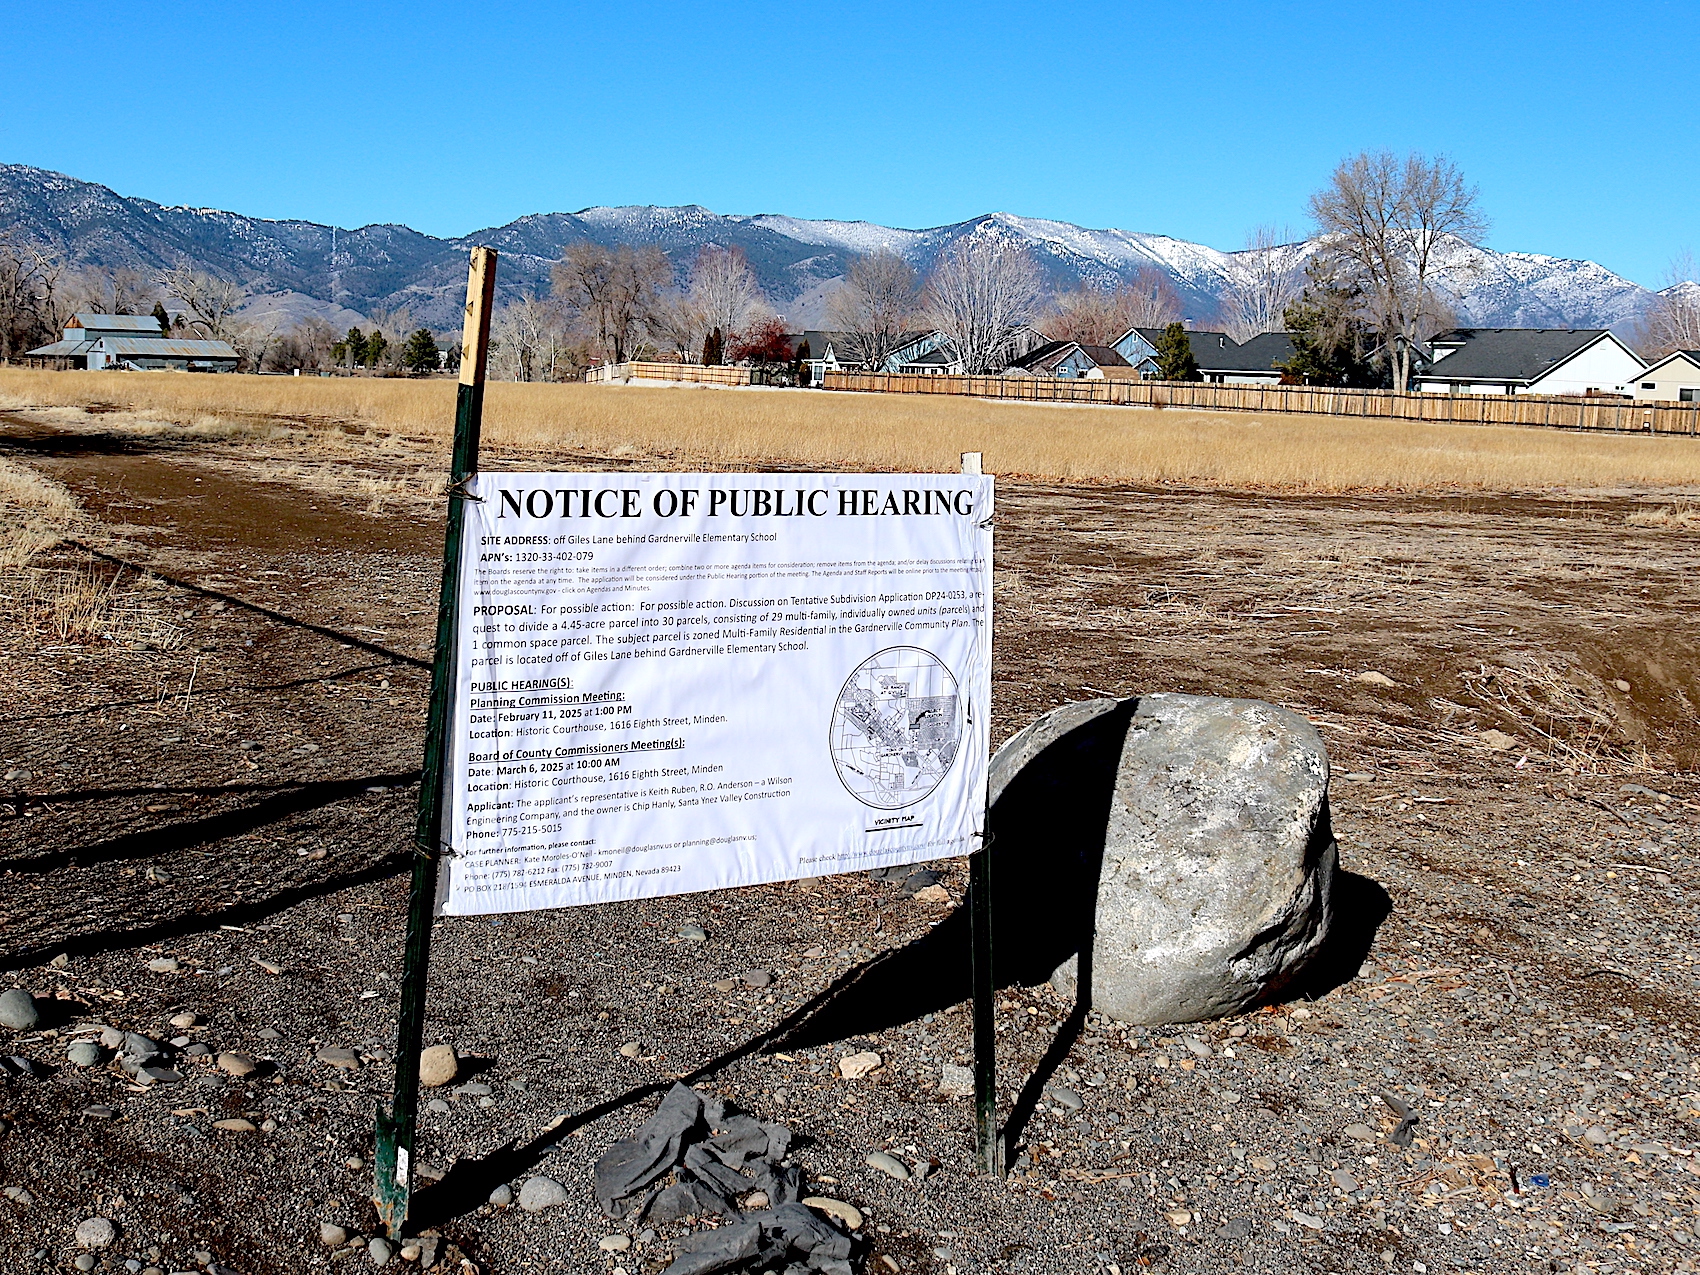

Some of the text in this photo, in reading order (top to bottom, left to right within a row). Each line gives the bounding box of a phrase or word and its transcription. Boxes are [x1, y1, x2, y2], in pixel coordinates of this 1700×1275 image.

[497, 489, 974, 518] NOTICE OF PUBLIC HEARING
[481, 532, 777, 546] SITE ADDRESS: off Giles Lane behind Gardnerville Elementary School
[516, 551, 594, 562] 1320-33-402-079
[586, 584, 611, 594] Agendas
[473, 590, 967, 616] PROPOSAL: For possible action: For possible action. Discussion Tentative Subdivision Application DP24-0253,
[472, 605, 970, 634] quest divide 4.45-acre parcel into 30 parcels, consisting 29 multi-family, individually owned units (parcels)
[482, 619, 970, 649] common space parcel. The subject parcel zoned Multi-Family Residential Gardnerville Community Plan.
[471, 641, 808, 668] parcel located Giles Lane behind Gardnerville Elementary School.
[471, 677, 573, 692] PUBLIC HEARING(S):
[470, 692, 625, 710] Planning Commission Meeting:
[470, 705, 632, 724] Date: February 11, 2025 1:00 PM
[470, 714, 727, 739] Location: Historic Courthouse, 1616 Eighth Street, Minden.
[468, 738, 685, 762] Board County Commissioners Meeting(s):
[467, 764, 723, 792] Location: Historic Courthouse, 1616 Eighth Street, Minden
[468, 757, 620, 777] Date: March 6, 2025 10:00 AM
[467, 801, 514, 812] Applicant:
[516, 799, 532, 807] The
[580, 790, 638, 802] representative
[648, 787, 669, 796] Keith
[671, 785, 697, 794] Ruben,
[700, 782, 715, 791] R.O.
[717, 780, 753, 789] Anderson
[768, 777, 792, 785] Wilson
[466, 790, 790, 826] Engineering Company, owner Chip Hanly, Santa Ynez Valley Construction
[466, 823, 562, 839] Phone: 775-215-5015
[548, 842, 568, 850] please
